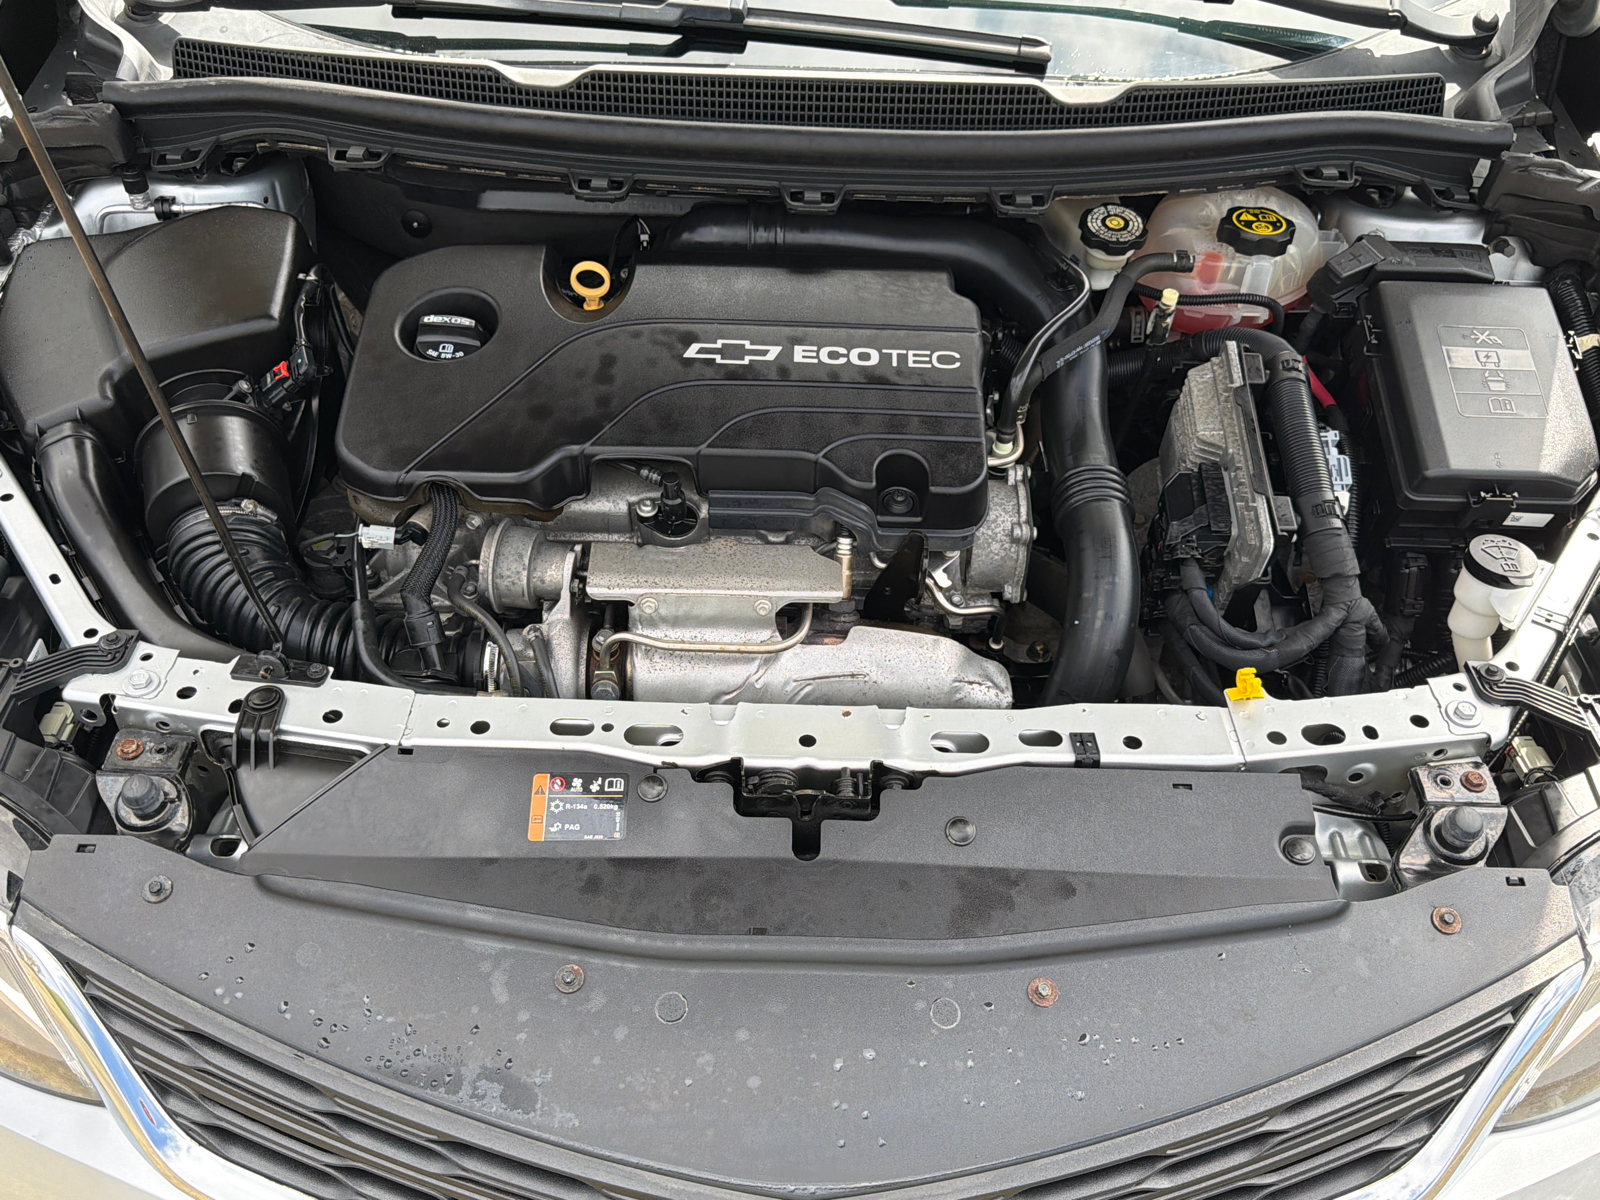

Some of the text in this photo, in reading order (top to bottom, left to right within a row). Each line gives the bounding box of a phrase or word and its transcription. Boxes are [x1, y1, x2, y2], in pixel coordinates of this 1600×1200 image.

[424, 314, 471, 325] dexos
[426, 349, 439, 358] SAE
[793, 345, 961, 369] ECOTEC
